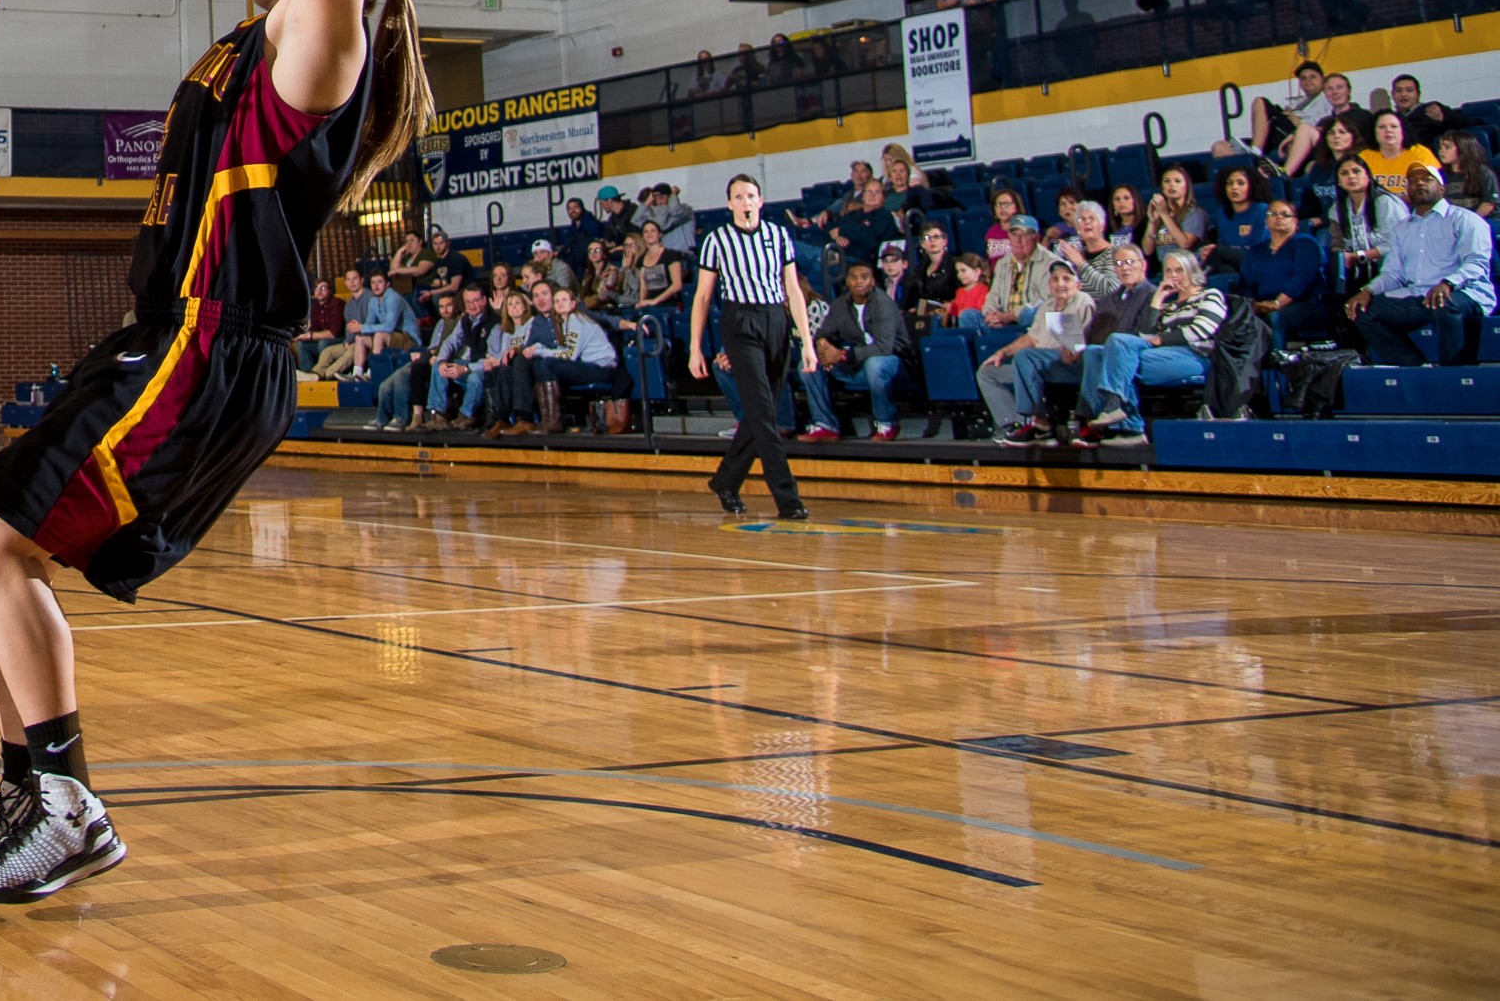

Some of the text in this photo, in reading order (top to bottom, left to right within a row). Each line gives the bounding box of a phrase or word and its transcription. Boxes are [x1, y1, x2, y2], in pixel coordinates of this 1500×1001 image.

[908, 21, 959, 54] SHOP
[927, 49, 959, 61] UNIVERSITY
[911, 59, 960, 78] BOOKSTORE
[427, 84, 597, 134] AUCOUS RANGERS
[464, 130, 501, 148] SPONSORED
[519, 128, 566, 146] Northwestern
[568, 124, 595, 137] Mutual
[115, 139, 161, 152] PANOR
[480, 146, 551, 160] BY West Denver
[108, 155, 151, 165] Orthopedics
[449, 154, 598, 196] STUDENT SECTION
[1375, 175, 1408, 188] EGIS
